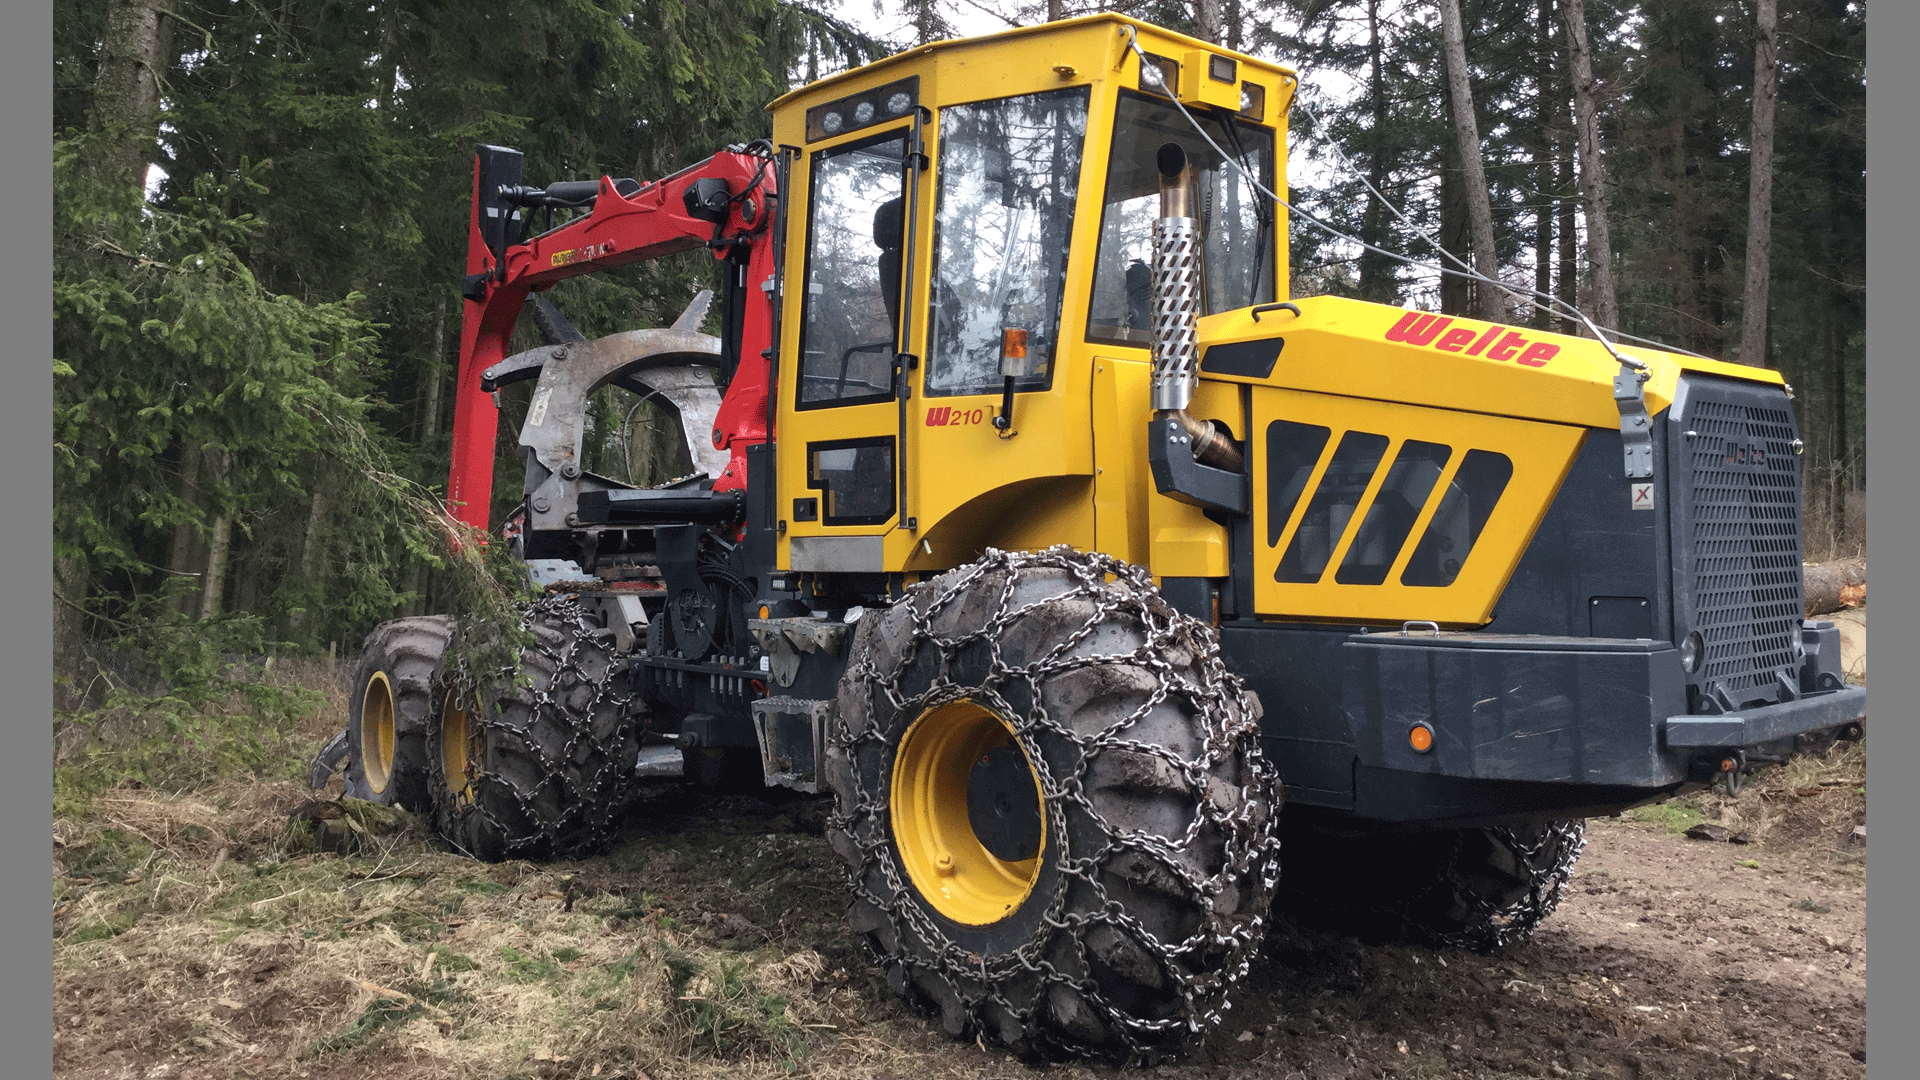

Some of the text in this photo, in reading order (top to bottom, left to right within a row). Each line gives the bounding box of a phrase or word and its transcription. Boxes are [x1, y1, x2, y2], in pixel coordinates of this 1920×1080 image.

[1384, 311, 1561, 368] Welte
[925, 406, 983, 427] W210
[1726, 442, 1765, 466] Welte
